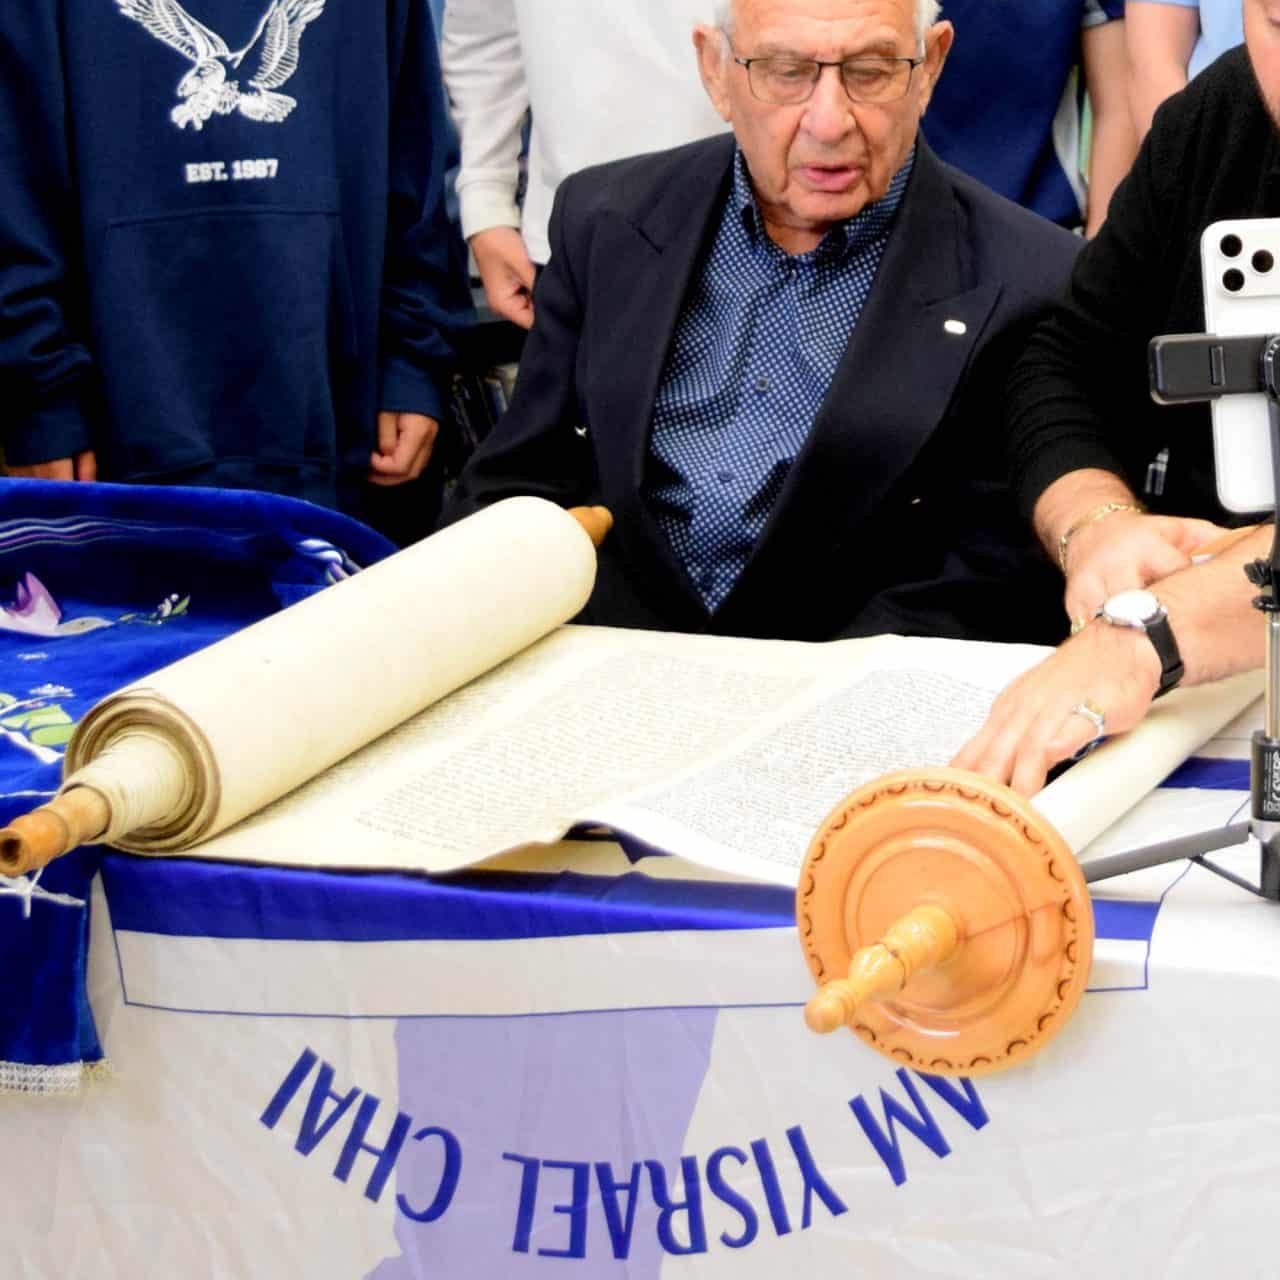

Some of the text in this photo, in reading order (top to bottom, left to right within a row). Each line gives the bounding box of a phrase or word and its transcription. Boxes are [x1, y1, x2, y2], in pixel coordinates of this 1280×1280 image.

[185, 161, 229, 184] EST.
[259, 1047, 463, 1224] CHAI
[503, 1125, 849, 1260] YISRAEL
